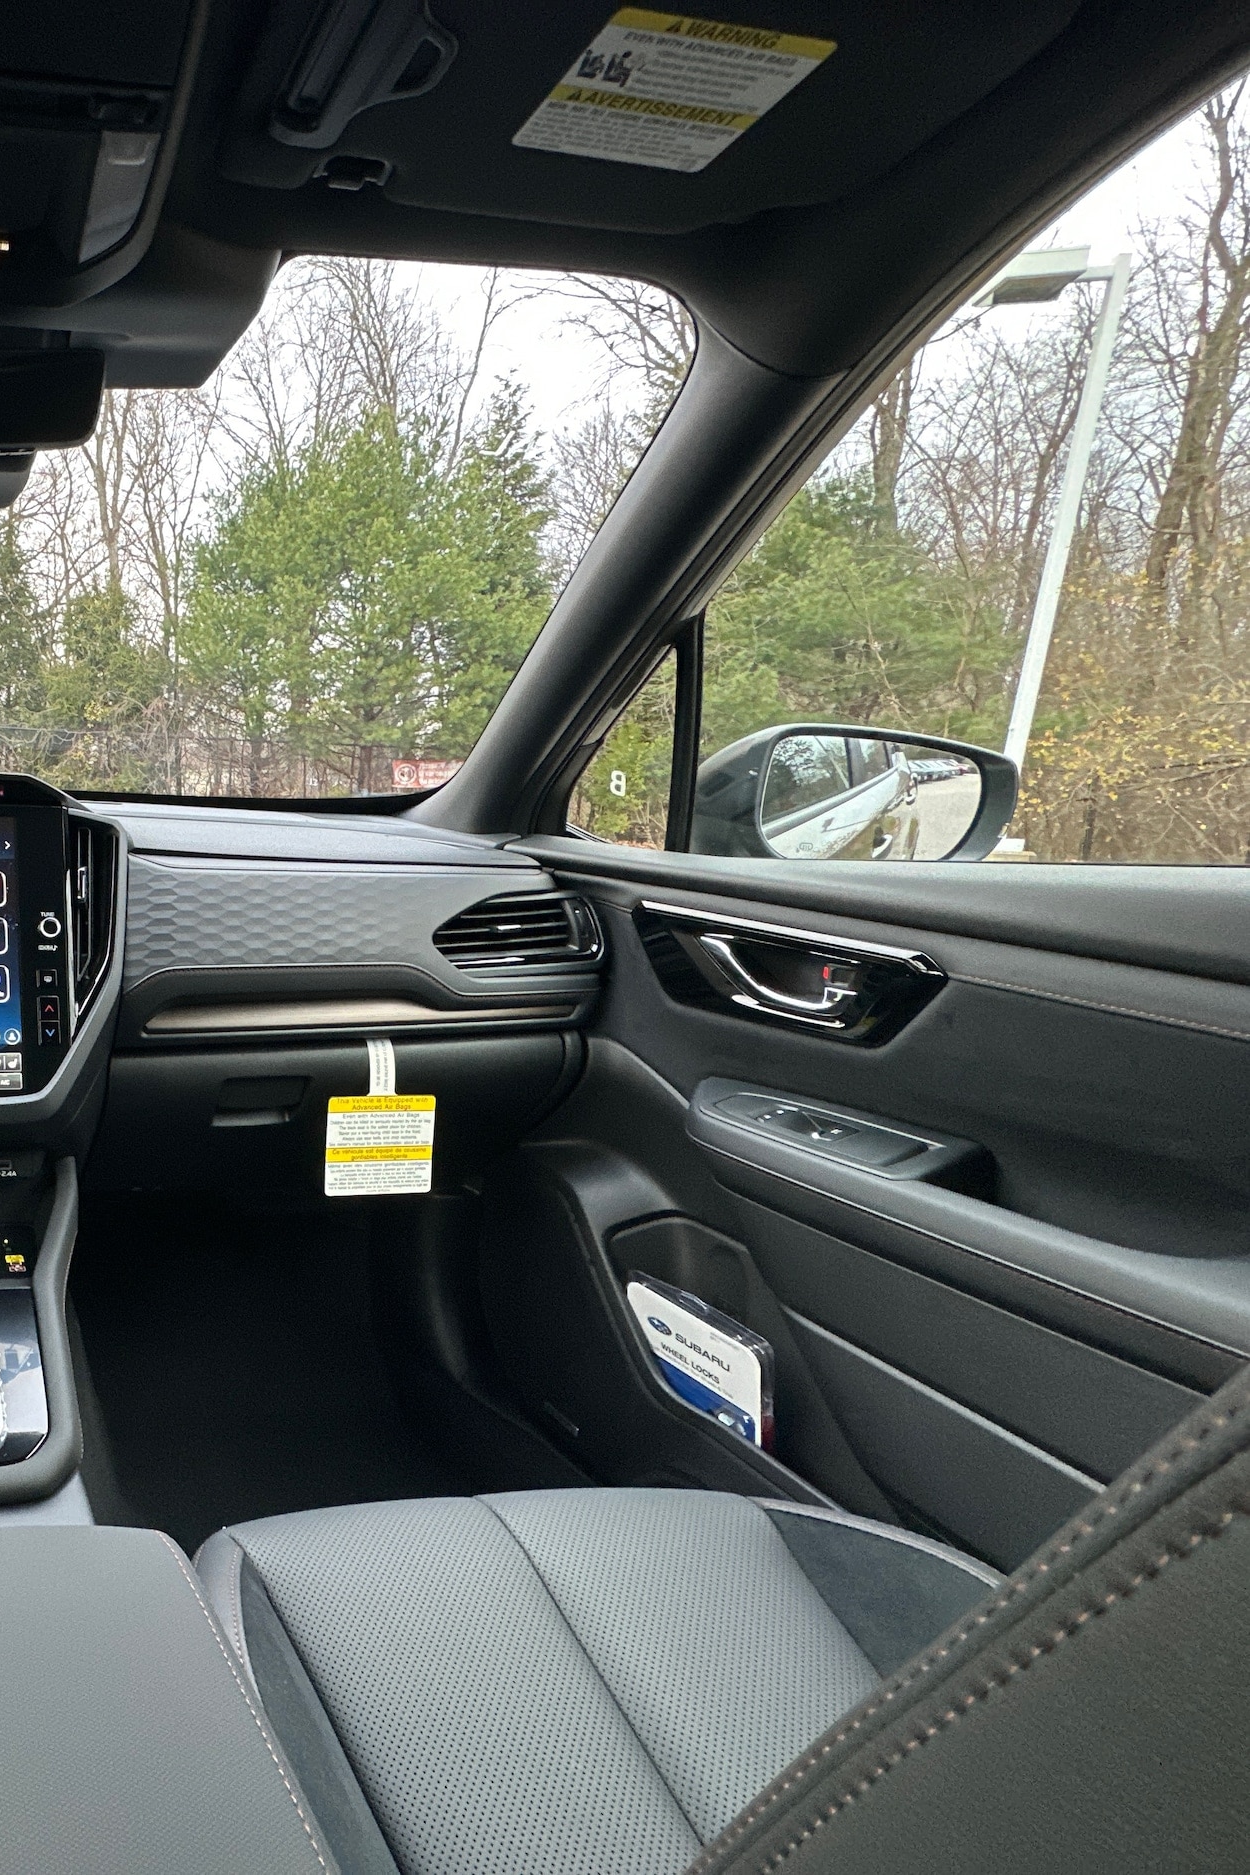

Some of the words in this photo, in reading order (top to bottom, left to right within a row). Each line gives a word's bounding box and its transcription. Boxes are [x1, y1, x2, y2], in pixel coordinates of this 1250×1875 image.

[684, 20, 780, 49] WARNING
[586, 90, 742, 126] AVERTISSEMENT
[660, 1341, 691, 1366] WHEEL
[691, 1360, 720, 1384] LOCKS
[674, 1333, 731, 1372] SUBARU
